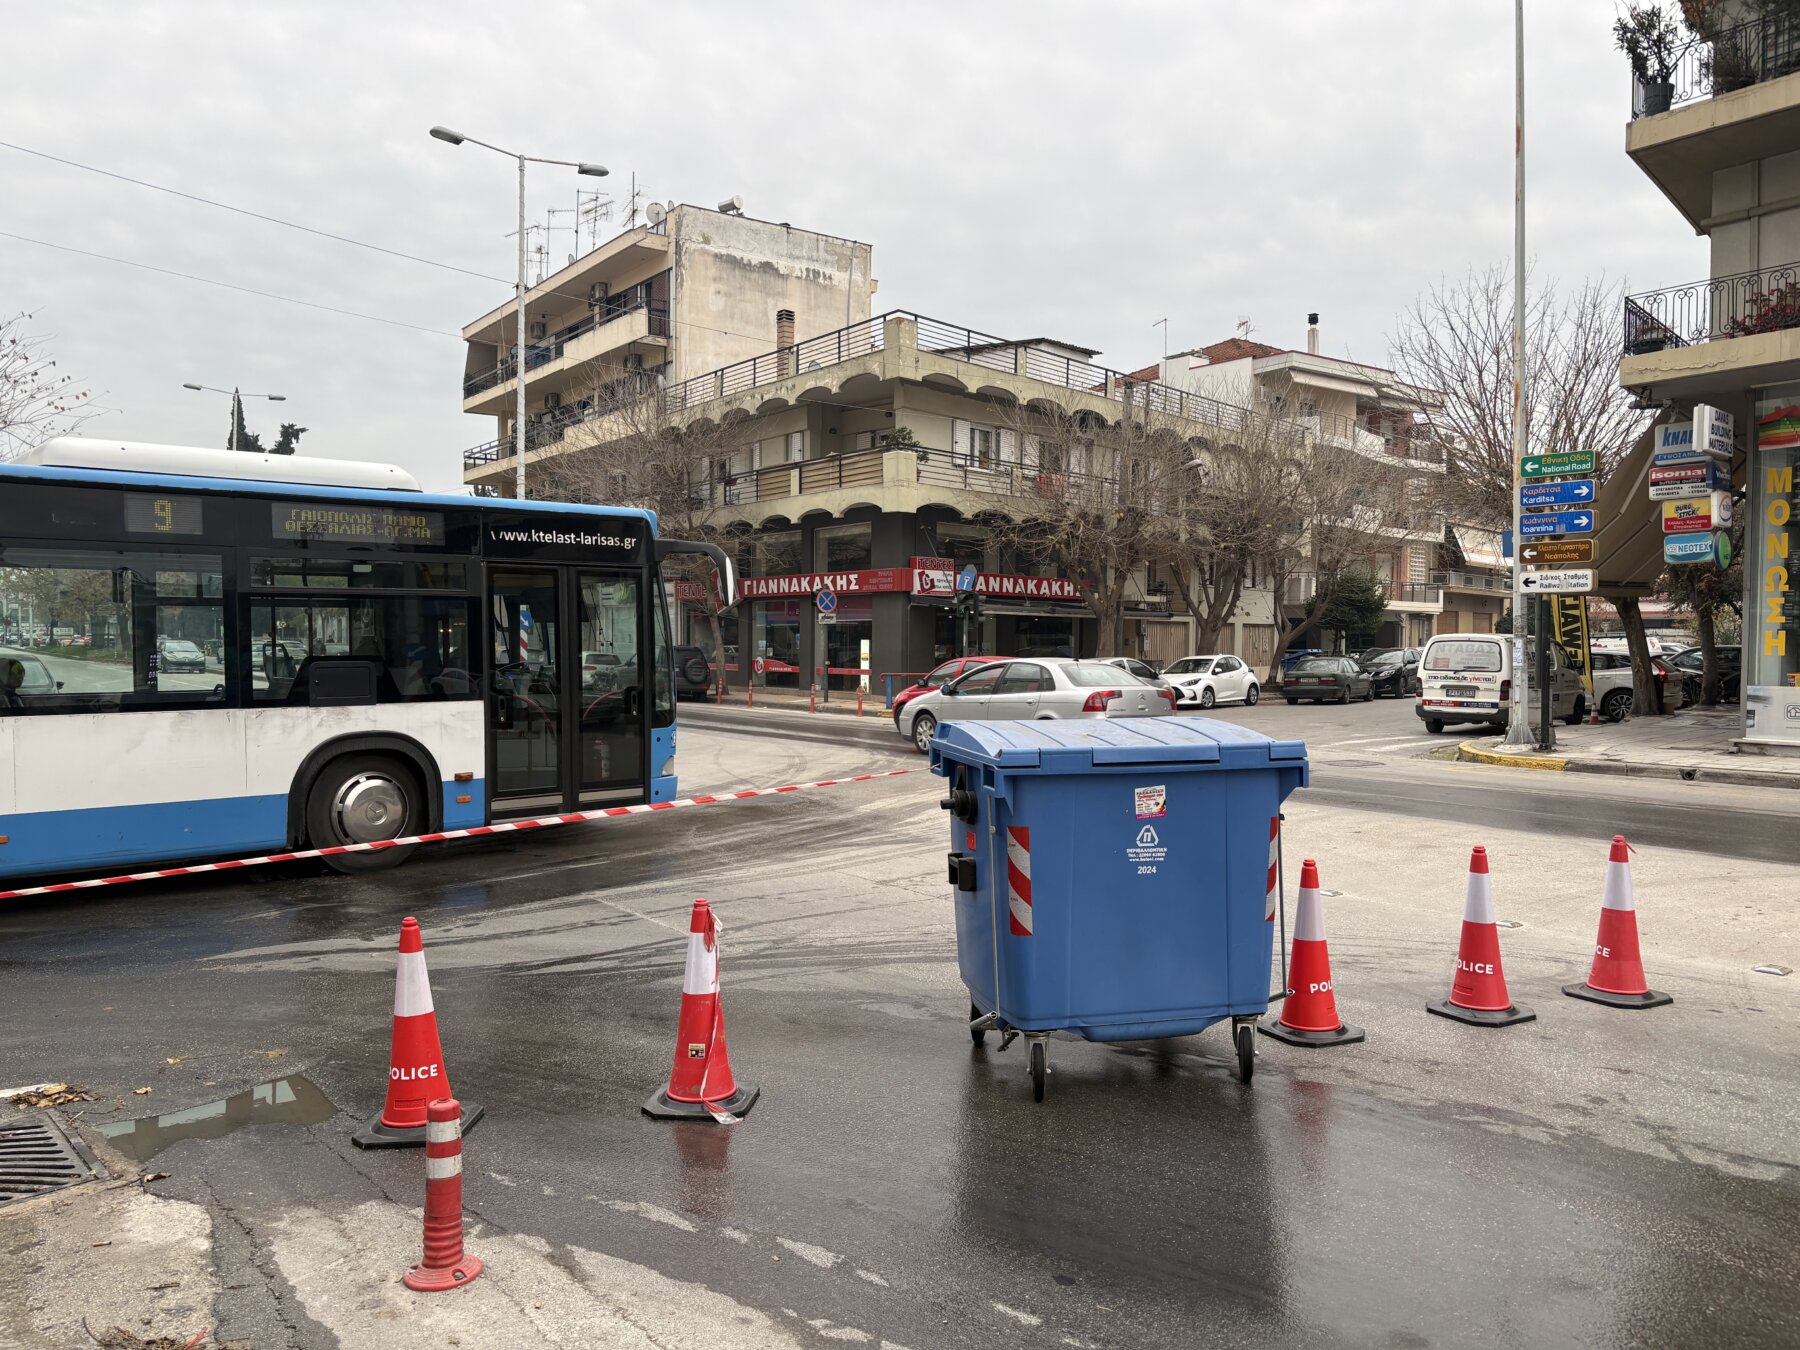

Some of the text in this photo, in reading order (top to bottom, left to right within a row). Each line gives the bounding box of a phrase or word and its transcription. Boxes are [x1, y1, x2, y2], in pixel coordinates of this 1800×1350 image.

[1714, 410, 1729, 425] DAVAS
[1711, 423, 1732, 440] BUILDING
[1709, 437, 1733, 455] MATERIALS
[1541, 462, 1591, 473] National Road
[1522, 495, 1555, 504] Karditsa
[154, 499, 172, 531] 9
[1678, 510, 1697, 518] STICK
[1522, 524, 1554, 533] Ioannina
[1678, 543, 1710, 553] NEOTEX
[1764, 466, 1793, 656] ΜΟΝΩΣΗ
[743, 573, 859, 596] ΓΙΑΝΝΑΚΑΚΗΣ
[957, 574, 1082, 597] ΑΝΝΑΚΑΚΗ
[1436, 643, 1496, 654] ΝΤΑΒΑΣ
[1137, 865, 1157, 874] 2024
[1457, 958, 1494, 975] OLICE
[389, 1063, 438, 1080] OLICE
